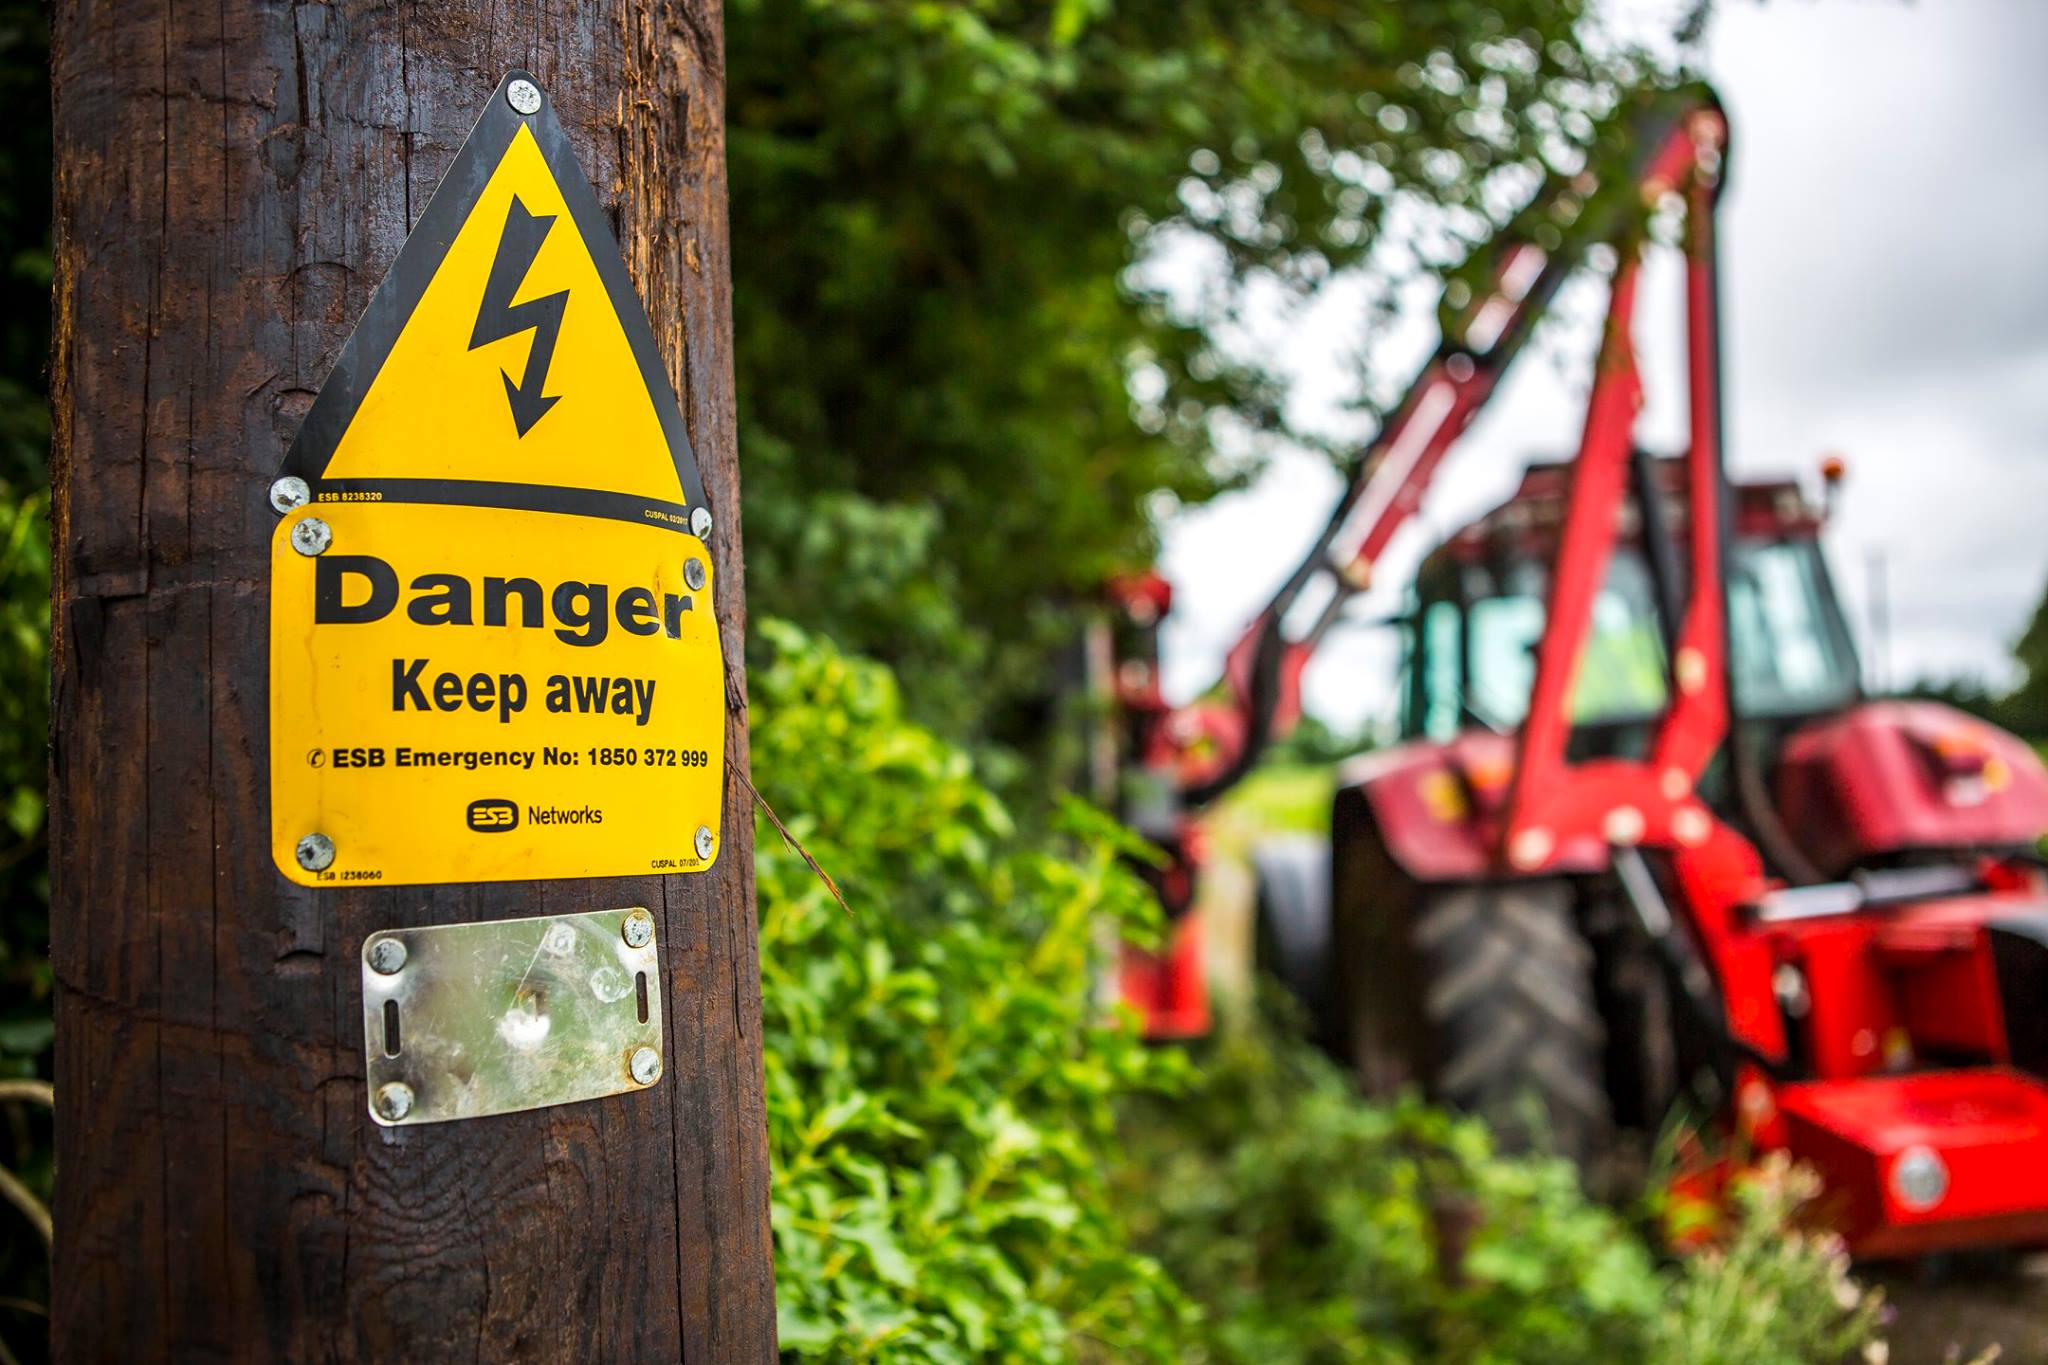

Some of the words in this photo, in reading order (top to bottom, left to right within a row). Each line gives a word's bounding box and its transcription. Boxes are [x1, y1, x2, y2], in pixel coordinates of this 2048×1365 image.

[318, 492, 339, 502] ESB
[644, 509, 669, 521] CUSPAL
[315, 554, 693, 647] Danger
[392, 659, 528, 723] Keep
[546, 674, 656, 726] away
[333, 748, 386, 768] ESB
[396, 747, 535, 770] Emergency
[543, 747, 579, 766] No:
[588, 748, 638, 766] 1850
[644, 749, 677, 767] 372
[681, 750, 708, 767] 999
[471, 805, 515, 827] ESB
[528, 805, 603, 825] Networks
[651, 860, 677, 868] CUSPAL
